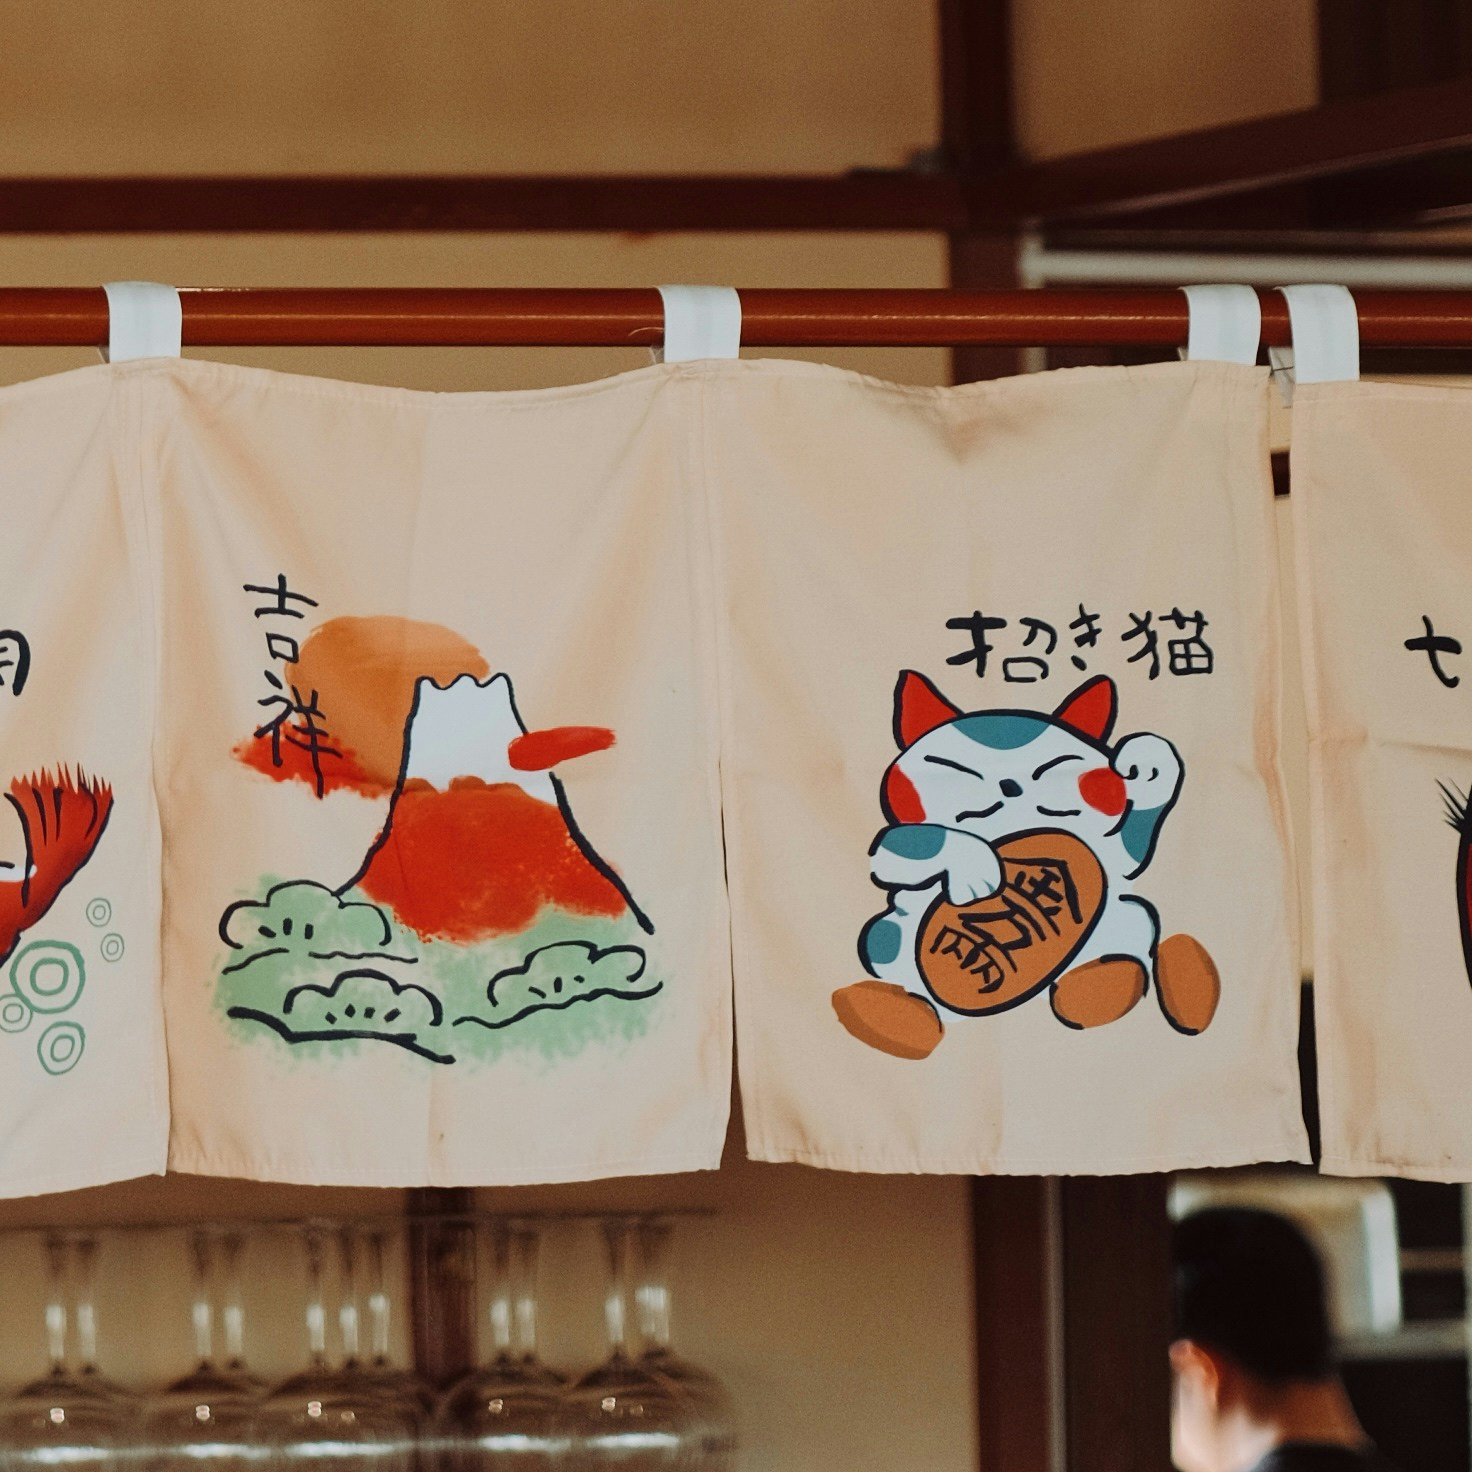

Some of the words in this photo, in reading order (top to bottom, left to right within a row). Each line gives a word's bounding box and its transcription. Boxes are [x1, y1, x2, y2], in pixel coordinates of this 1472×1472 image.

[242, 573, 344, 800] 吉祥
[945, 602, 1215, 683] 招き猫
